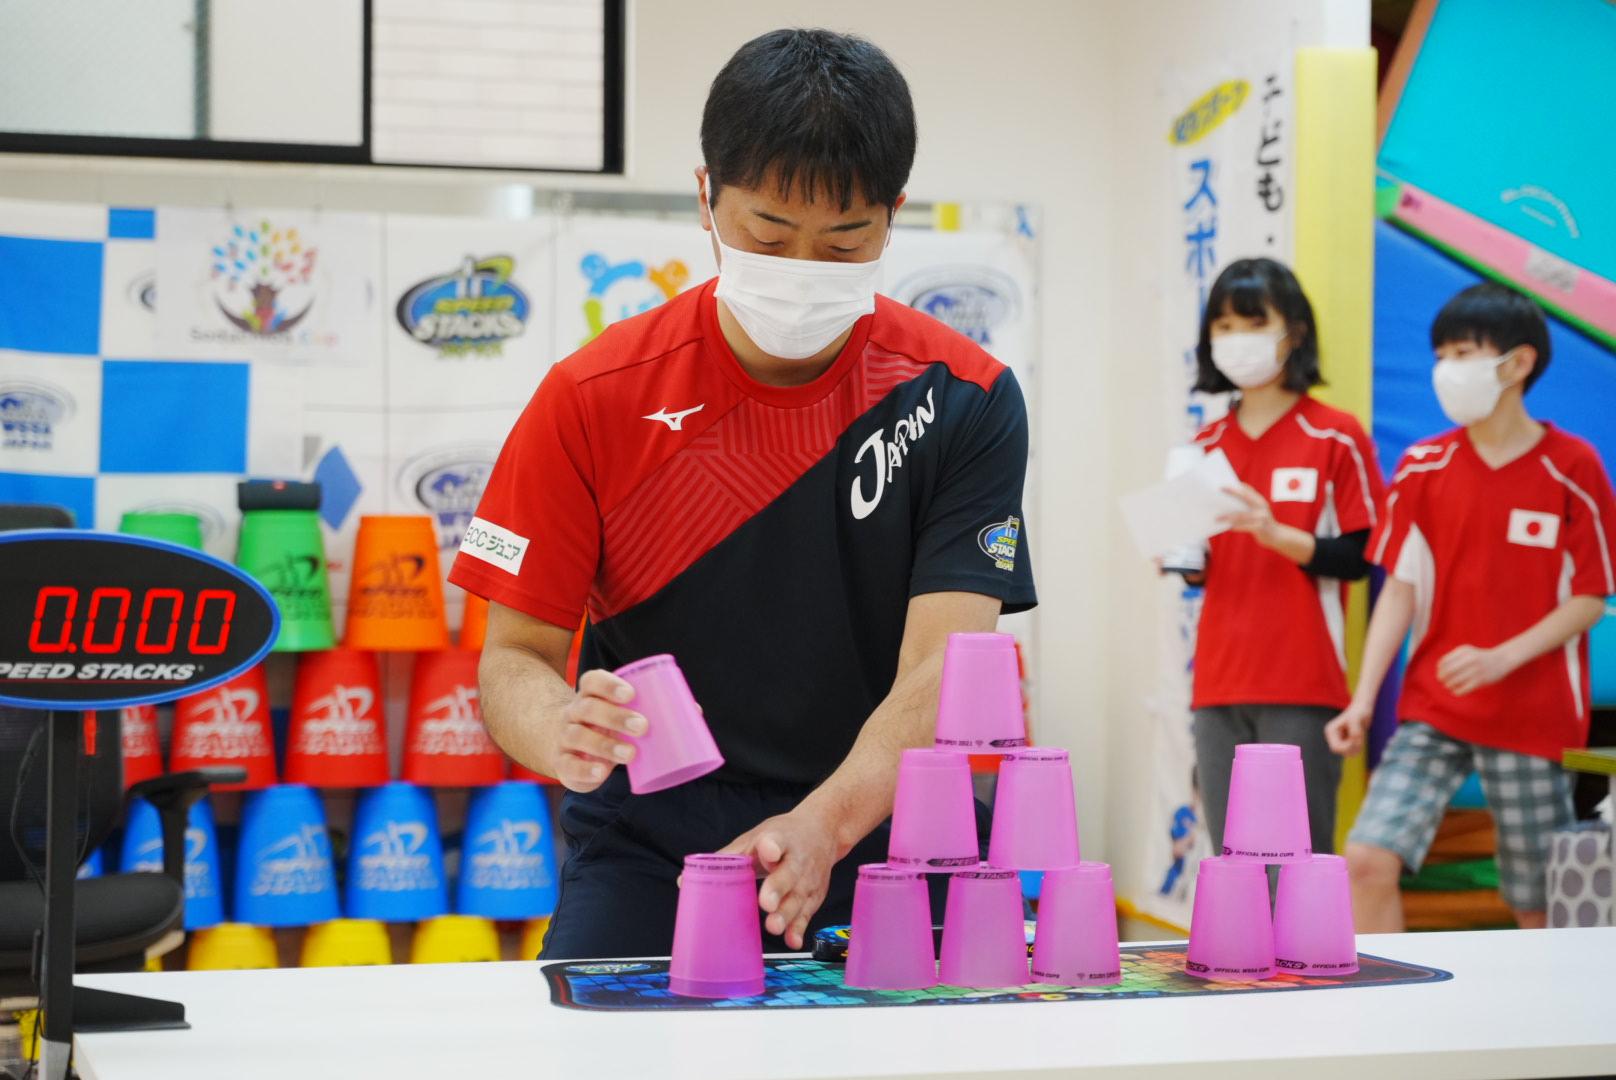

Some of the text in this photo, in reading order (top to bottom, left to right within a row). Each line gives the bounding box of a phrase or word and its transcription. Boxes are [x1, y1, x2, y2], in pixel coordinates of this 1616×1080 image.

[851, 386, 935, 520] JAPAN
[29, 586, 237, 654] 0.000
[77, 663, 196, 680] STACKS
